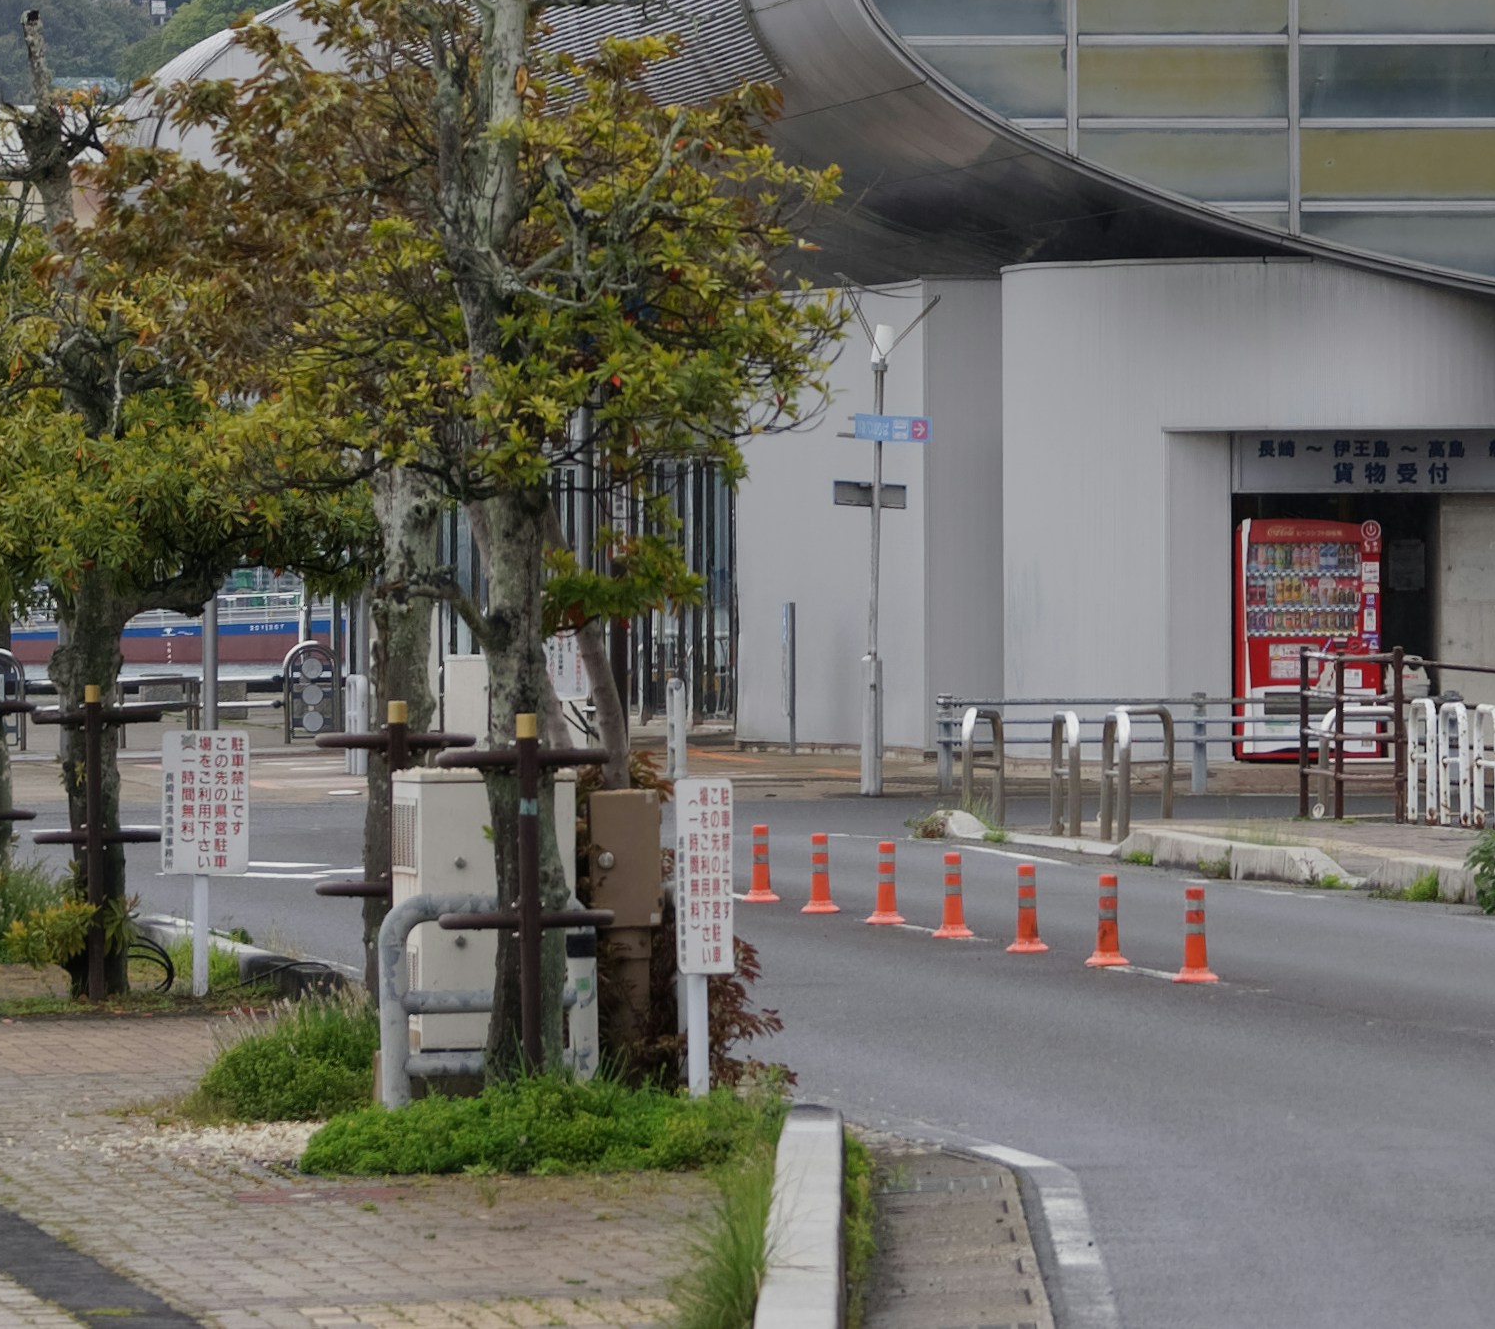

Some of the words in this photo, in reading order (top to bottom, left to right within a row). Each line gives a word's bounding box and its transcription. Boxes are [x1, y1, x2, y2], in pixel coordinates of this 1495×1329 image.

[1332, 462, 1450, 485] 貨物受付
[214, 737, 228, 869] この先の県営駐車
[230, 736, 245, 836] 駐車禁止です
[720, 787, 731, 920] 駐車禁止です
